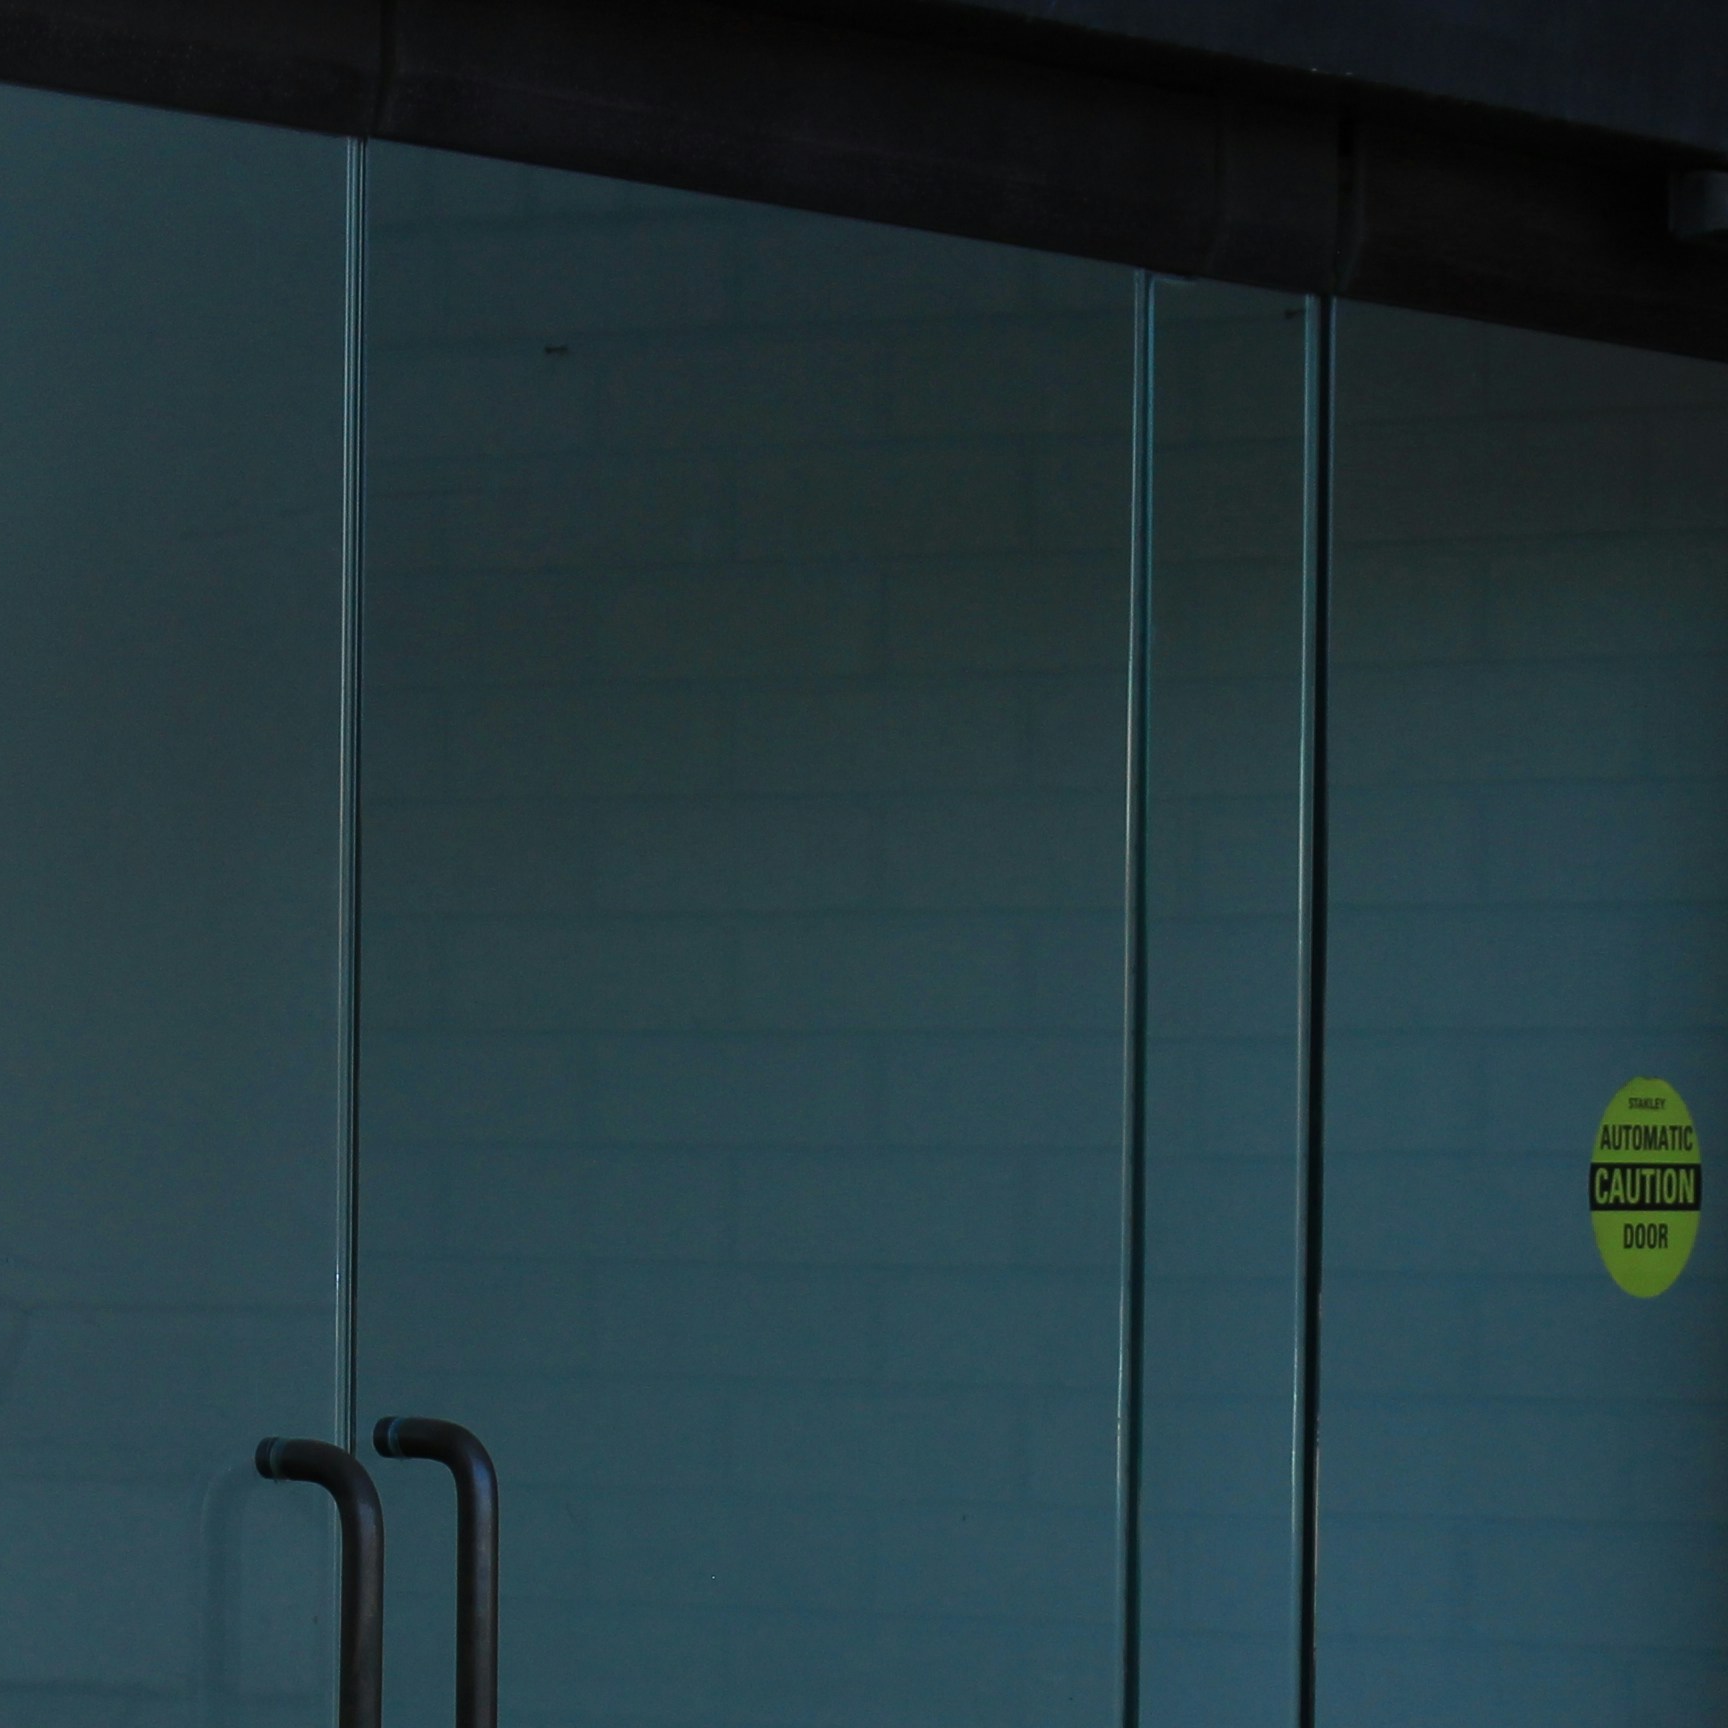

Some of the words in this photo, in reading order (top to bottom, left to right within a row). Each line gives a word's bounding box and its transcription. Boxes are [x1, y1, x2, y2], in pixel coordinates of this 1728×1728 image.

[1600, 1124, 1693, 1151] AUTOMATIC
[1594, 1168, 1696, 1204] CAUTION
[1623, 1223, 1669, 1249] DOOR
